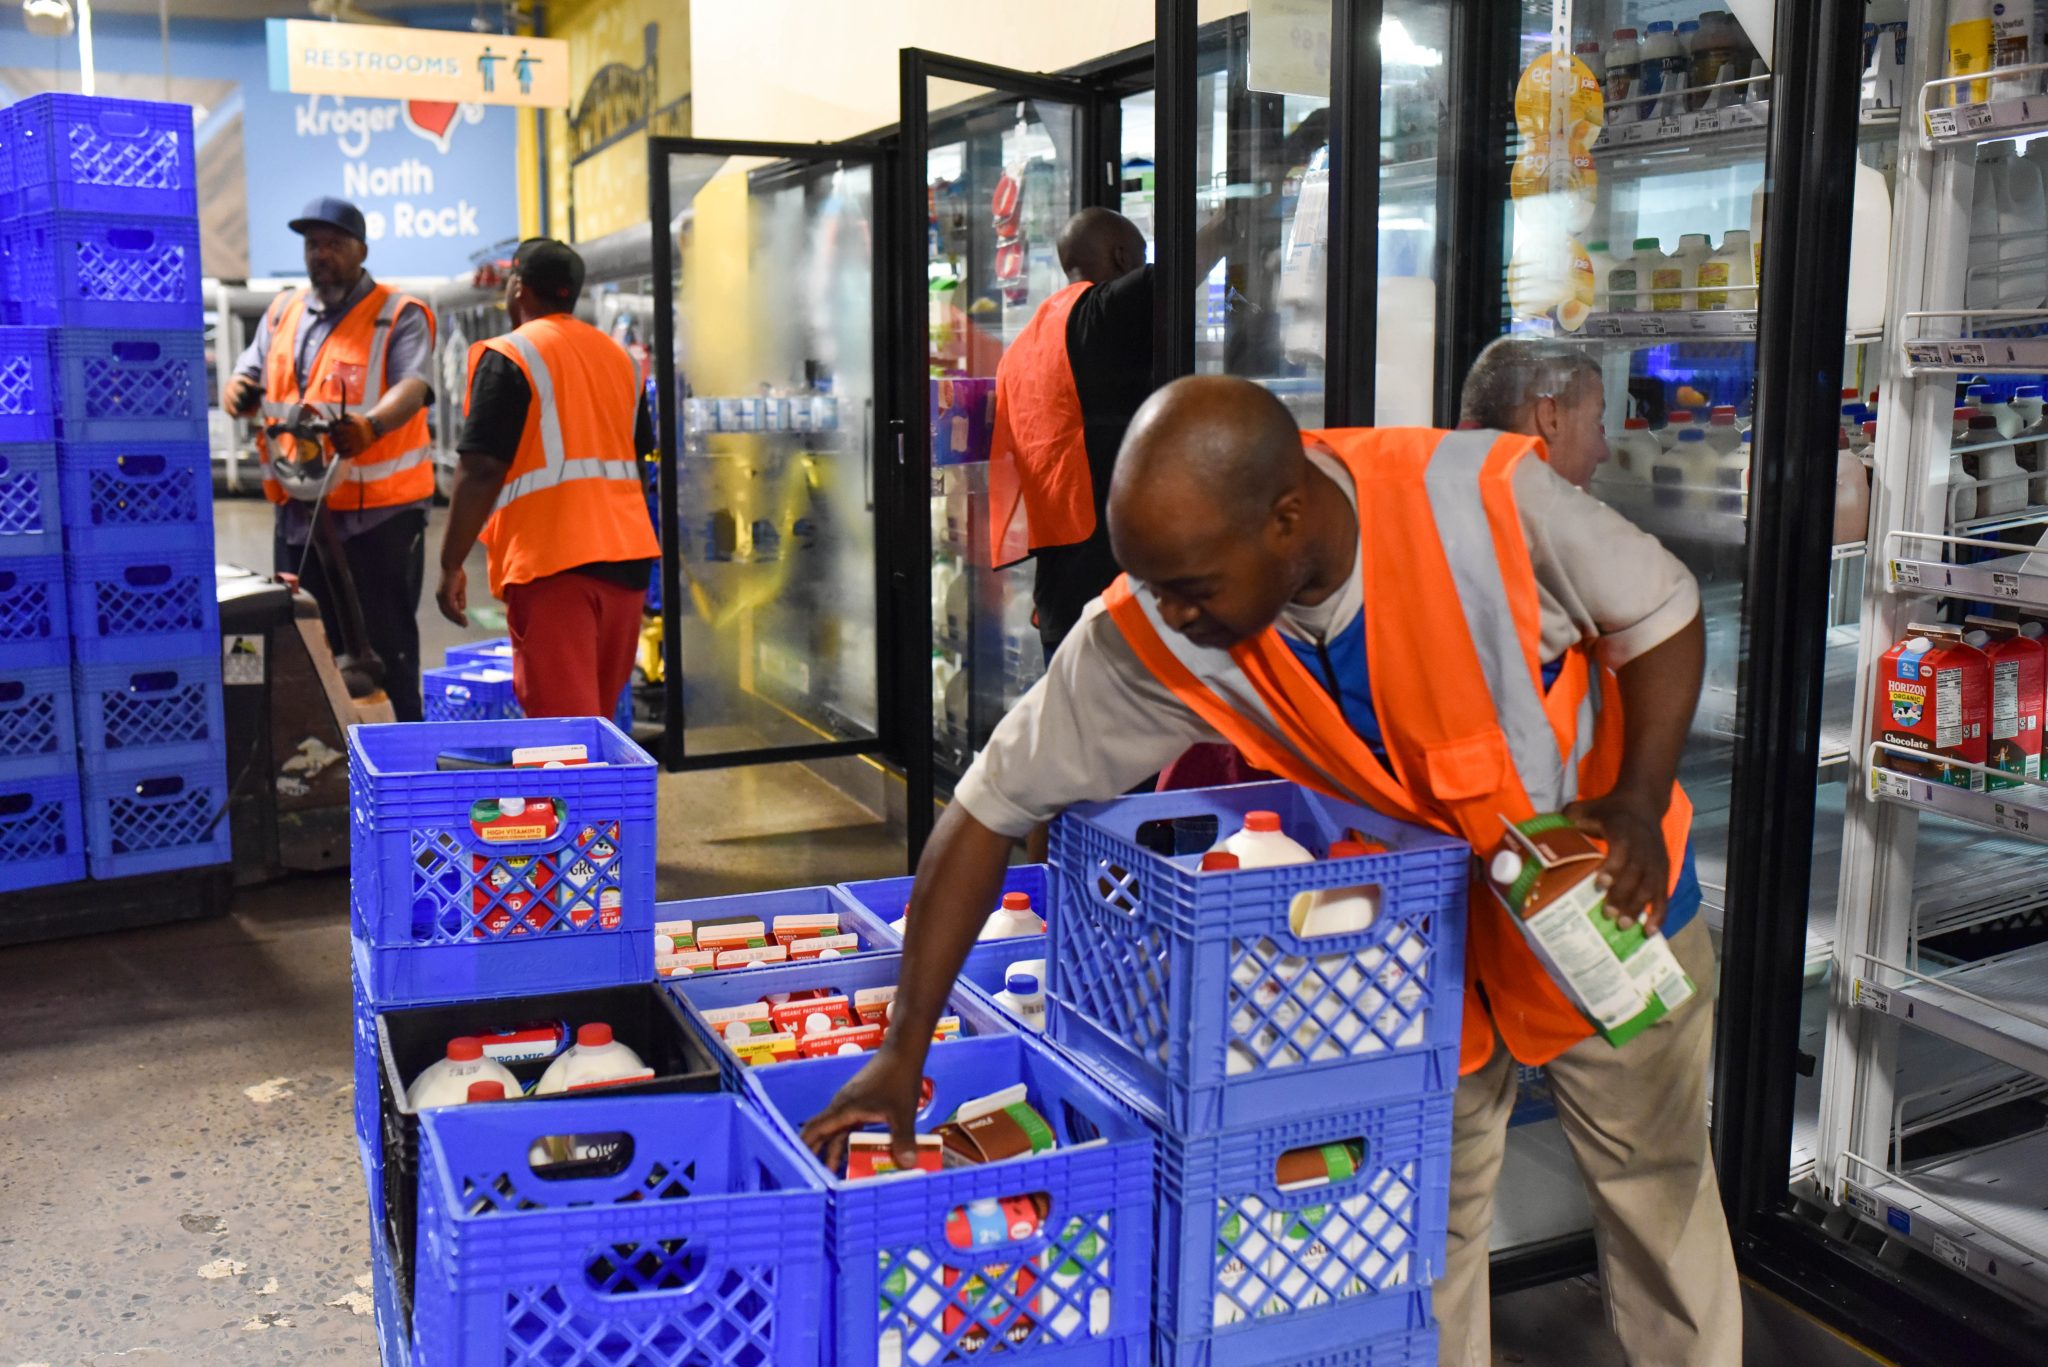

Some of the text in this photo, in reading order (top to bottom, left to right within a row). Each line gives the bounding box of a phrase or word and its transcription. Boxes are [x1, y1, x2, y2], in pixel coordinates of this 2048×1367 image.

[304, 48, 460, 75] RESTROOMS
[296, 95, 398, 157] Kroger
[344, 159, 434, 198] North
[394, 200, 479, 238] Rock
[2006, 587, 2019, 596] 3.99
[1902, 662, 1915, 672] 2%
[1888, 680, 1927, 697] HORIZON
[1893, 692, 1921, 703] ORGANIC
[1885, 733, 1929, 750] Chocolate
[1896, 788, 1909, 797] 6.49
[979, 1229, 1000, 1242] 2%
